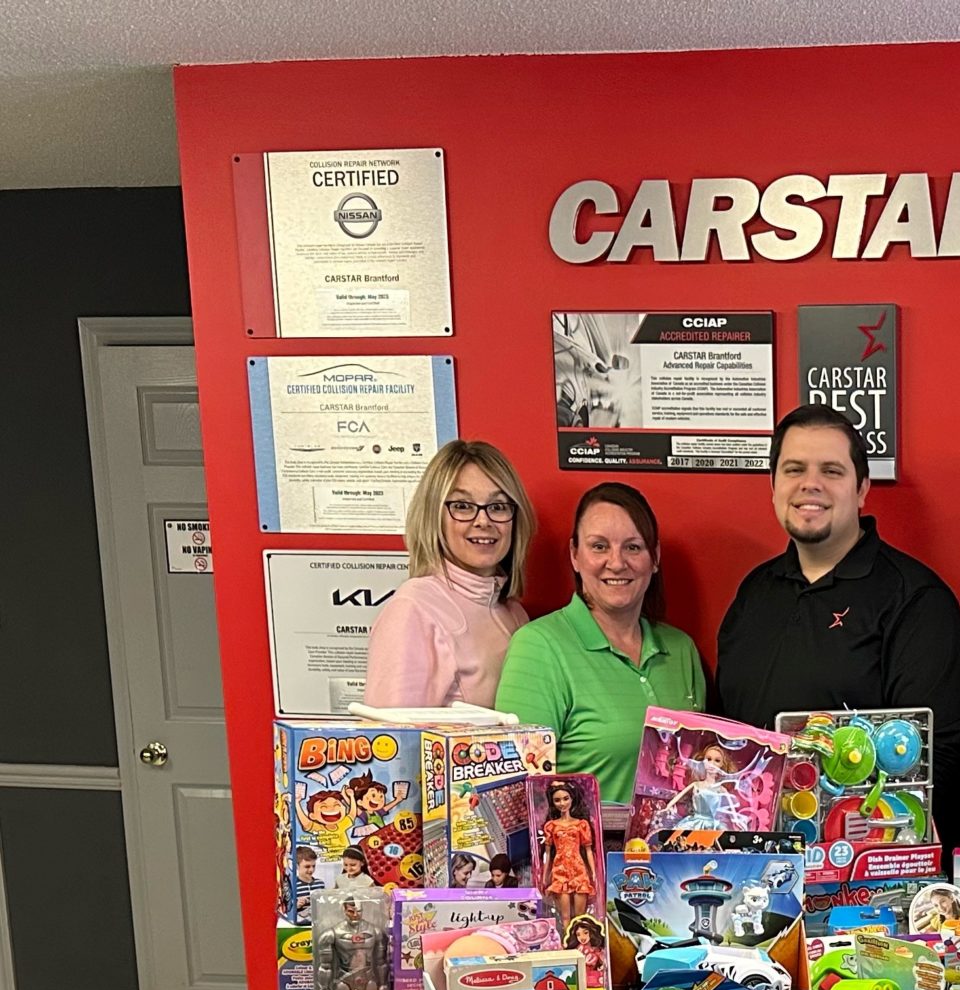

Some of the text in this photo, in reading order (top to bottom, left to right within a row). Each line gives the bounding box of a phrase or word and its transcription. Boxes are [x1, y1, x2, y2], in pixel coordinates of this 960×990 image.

[312, 170, 399, 187] CERTIFIED
[325, 275, 362, 283] CARSTAR
[682, 318, 727, 328] CCIAP
[660, 331, 751, 341] ACCREDITED REPAIRER
[674, 351, 741, 360] CARSTAR Brantford
[694, 362, 713, 370] Repair
[715, 362, 752, 370] Capabilities
[323, 374, 374, 382] MOPAR
[808, 367, 887, 388] CARSTAR
[287, 384, 415, 394] CERTIFIED COLLISION REPAIR FACILITY
[355, 403, 389, 411] Brantford
[337, 421, 371, 433] FCA
[695, 459, 714, 467] 2020
[720, 459, 739, 467] 2021
[745, 459, 763, 467] 2022
[452, 741, 521, 766] CODE
[452, 761, 525, 781] BREAKER
[834, 845, 849, 858] 23
[867, 852, 934, 863] Dish Drainer Playset
